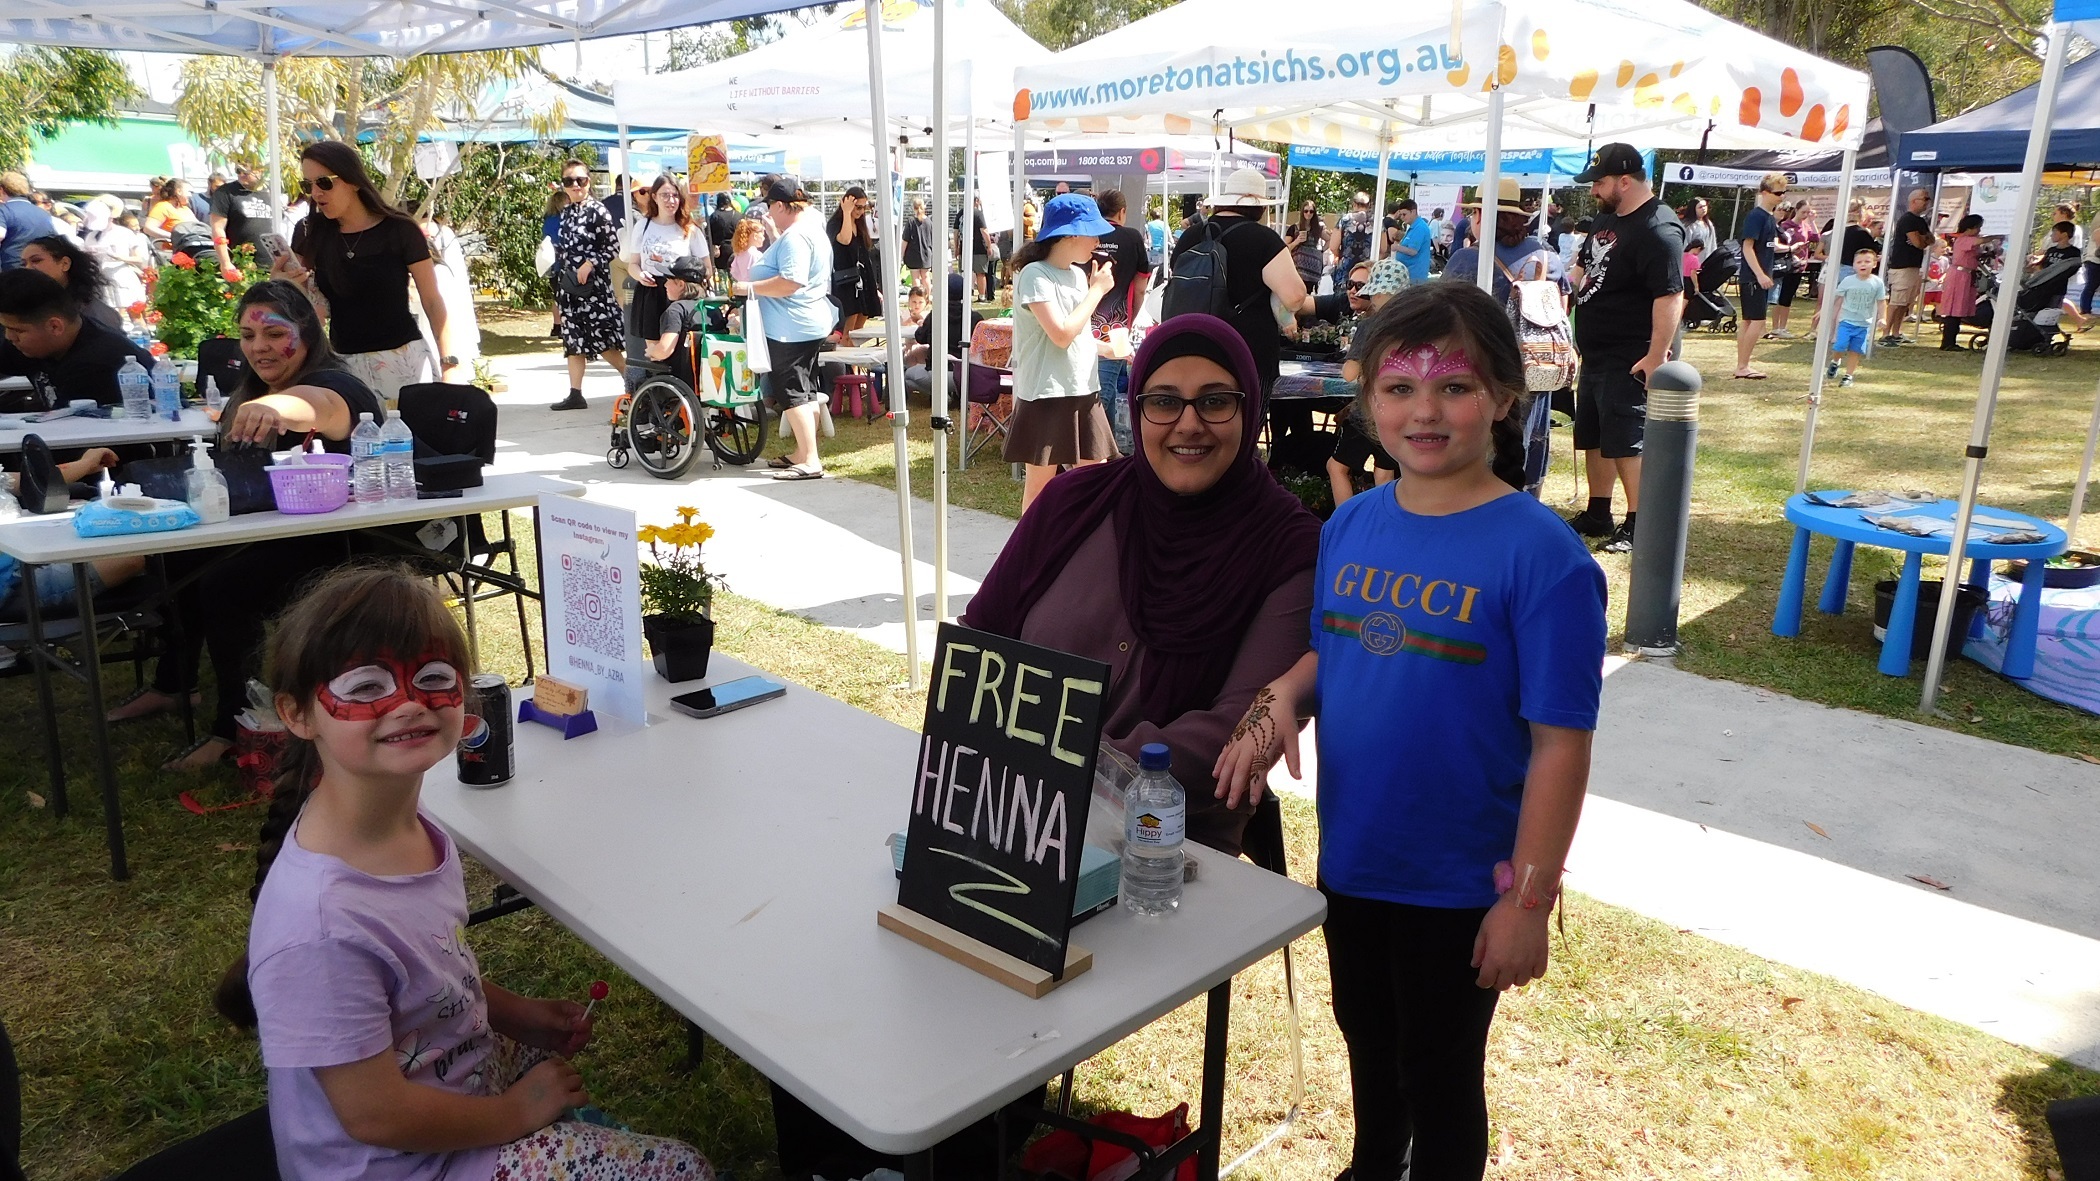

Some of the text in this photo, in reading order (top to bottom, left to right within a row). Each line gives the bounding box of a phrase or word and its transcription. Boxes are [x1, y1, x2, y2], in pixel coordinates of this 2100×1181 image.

[728, 76, 738, 85] WE
[1030, 43, 1463, 111] www.moretonatsichs.org.au
[729, 86, 820, 99] LIFE WITHOUT BARRIERS
[1078, 156, 1098, 165] 1800
[1099, 156, 1115, 165] 662
[1117, 155, 1133, 165] 837
[1294, 146, 1321, 155] RSPCA
[1337, 147, 1380, 161] People
[1393, 150, 1422, 161] Pets
[1500, 150, 1532, 160] RSPCA
[550, 514, 629, 540] Scan QR code to view my
[573, 531, 605, 546] Instagram
[1334, 563, 1481, 624] GUCCI
[568, 655, 625, 684] @HENNA_BY_AZRA
[936, 642, 1103, 768] FREE
[916, 735, 1067, 883] HENNA
[1136, 827, 1162, 839] Hippy
